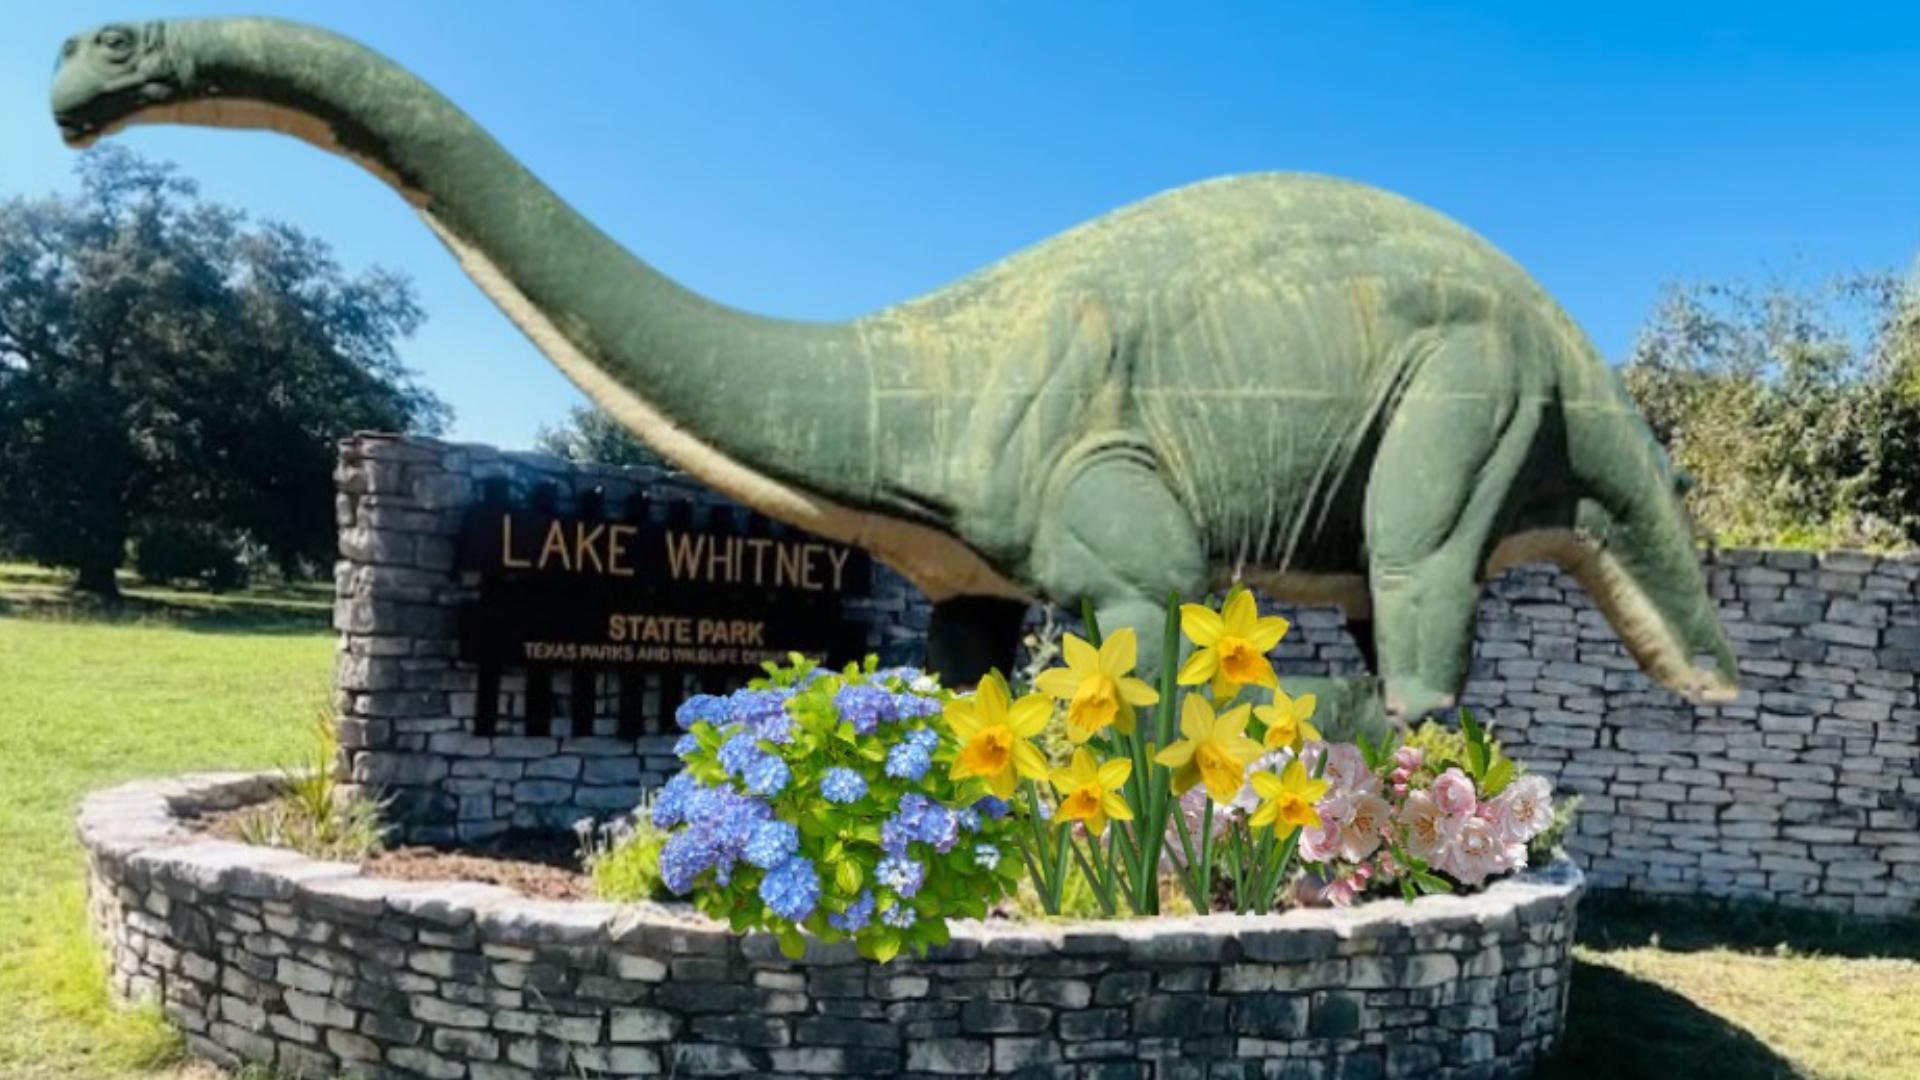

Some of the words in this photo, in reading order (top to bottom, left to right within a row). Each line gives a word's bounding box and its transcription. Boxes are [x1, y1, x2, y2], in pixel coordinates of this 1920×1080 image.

[502, 513, 638, 576] LAKE
[665, 530, 850, 590] WHITNEY
[608, 614, 691, 643] STATE
[698, 619, 765, 646] PARK
[523, 641, 577, 660] TEXAS
[580, 643, 633, 662] PARKS
[637, 645, 669, 662] AND
